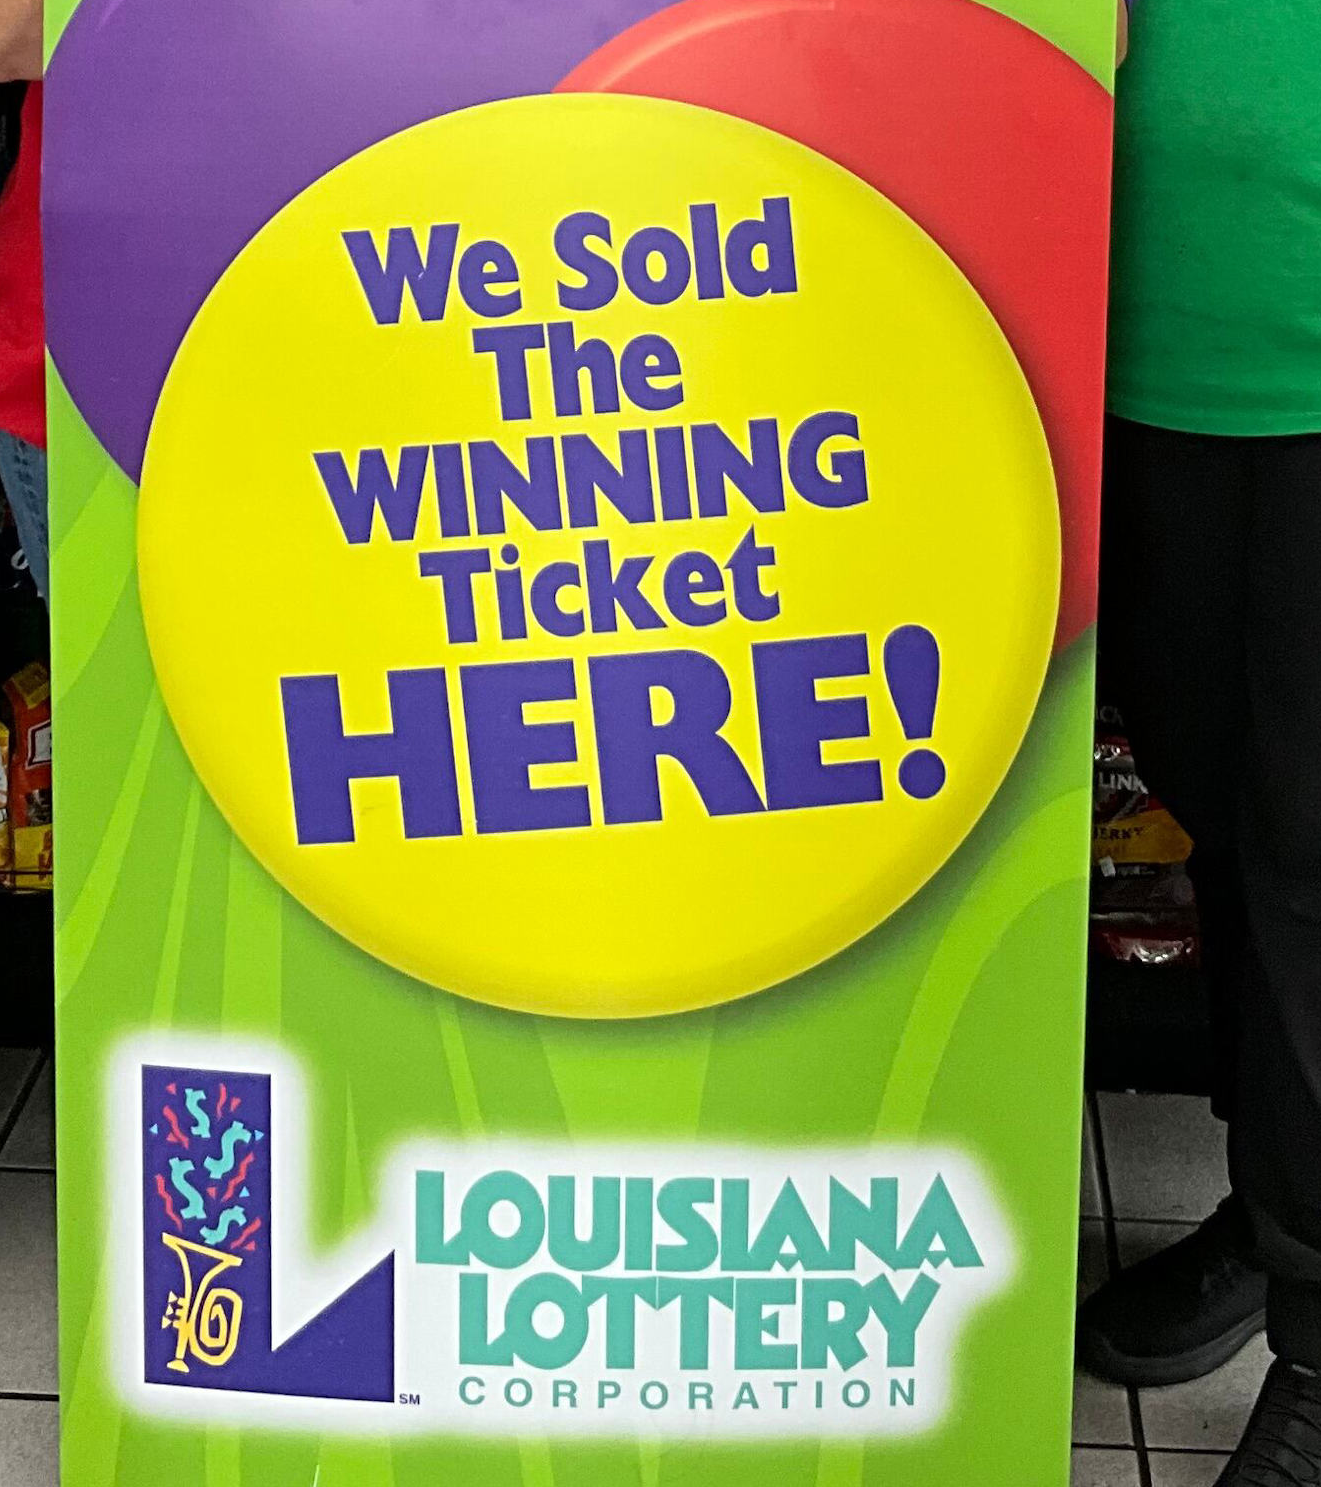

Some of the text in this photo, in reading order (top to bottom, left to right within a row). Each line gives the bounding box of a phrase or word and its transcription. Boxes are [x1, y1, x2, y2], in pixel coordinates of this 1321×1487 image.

[342, 195, 799, 327] We Sold
[472, 320, 686, 421] The
[312, 410, 869, 546] WINNING
[418, 523, 781, 645] Ticket
[280, 623, 948, 846] HERE!
[413, 1169, 984, 1273] LOUISIANA
[457, 1271, 942, 1374] LOTTERY
[457, 1376, 916, 1412] CORPORATION
